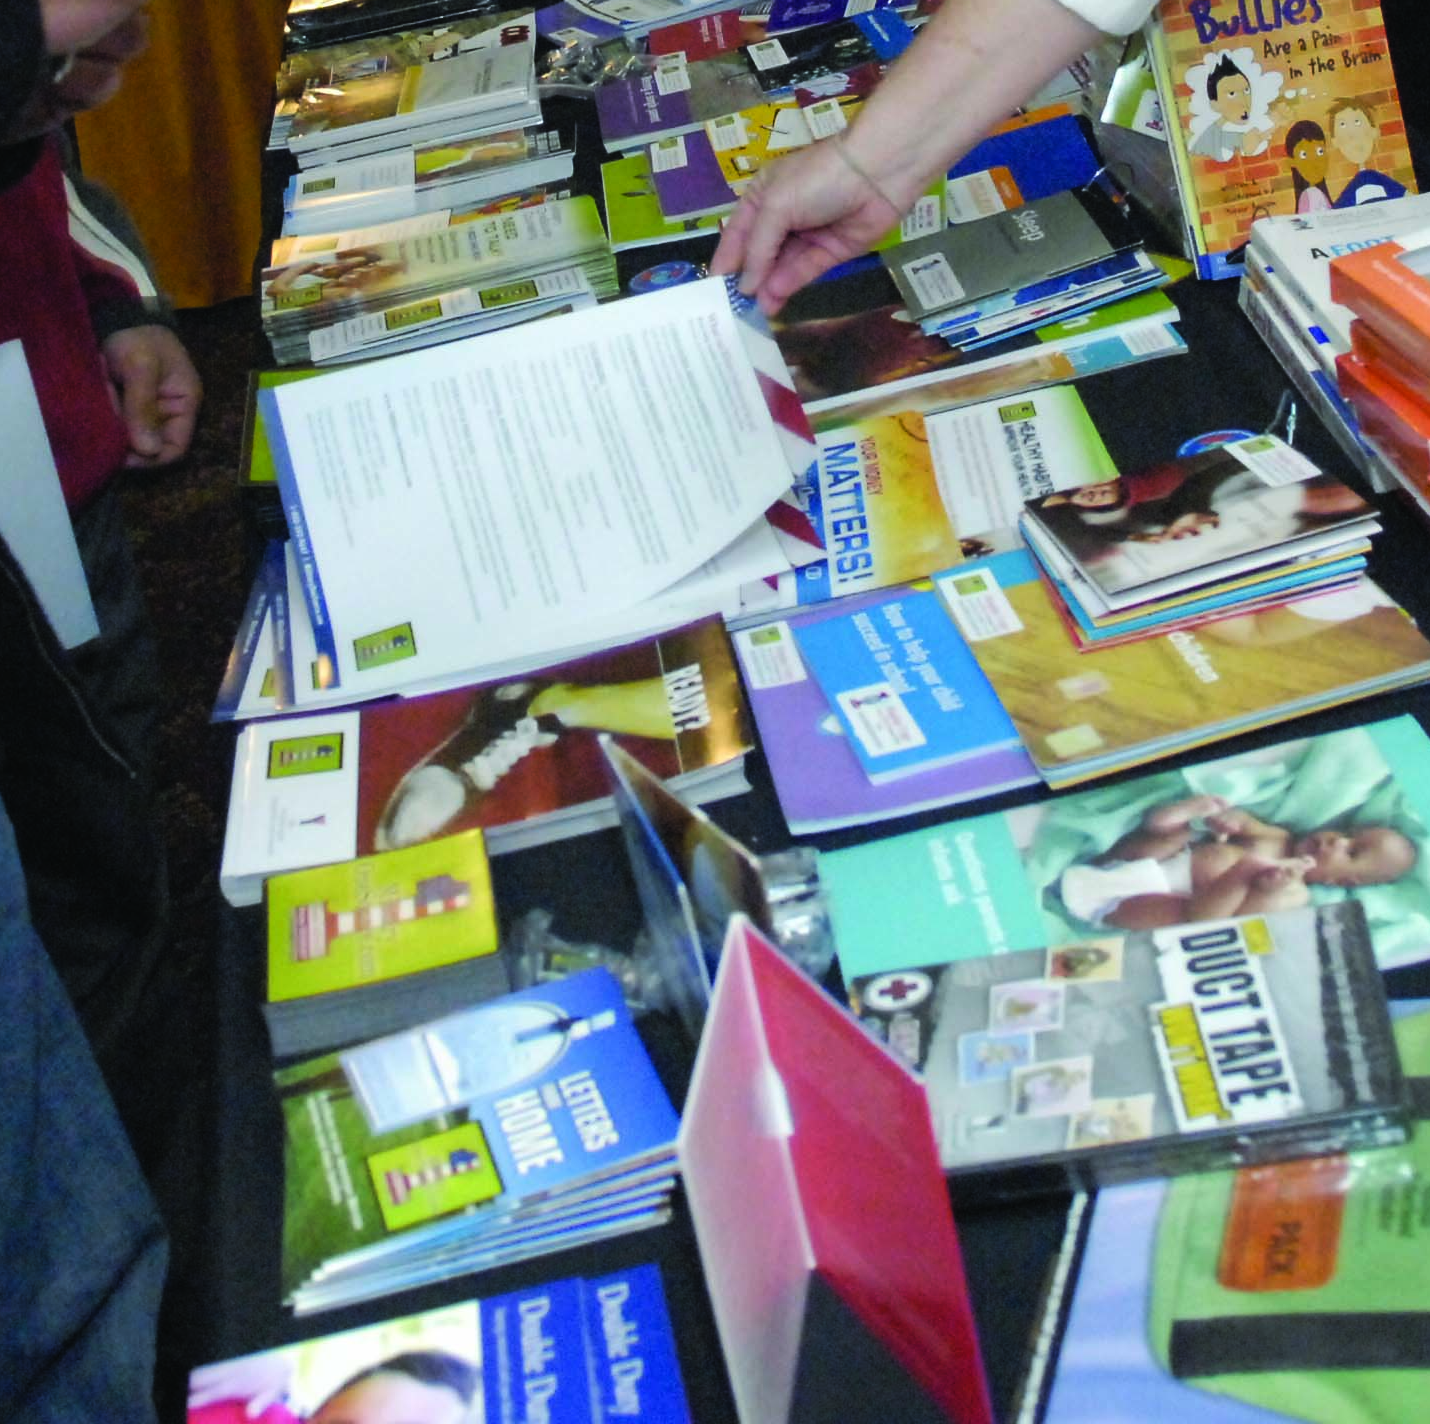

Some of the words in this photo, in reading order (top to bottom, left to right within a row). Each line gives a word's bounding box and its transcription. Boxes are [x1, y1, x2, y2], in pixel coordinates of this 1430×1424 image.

[1263, 39, 1291, 58] Are
[1298, 38, 1307, 51] a
[1312, 25, 1343, 49] Pain
[1288, 60, 1303, 79] in
[1309, 58, 1335, 76] the
[1341, 44, 1382, 68] Brain
[859, 435, 878, 461] YOUR
[823, 441, 874, 584] MATTERS!
[1179, 927, 1262, 1014] DUCT
[1208, 1018, 1292, 1105] TAPE
[493, 1088, 564, 1175] HOME
[558, 1069, 620, 1153] LETTERS
